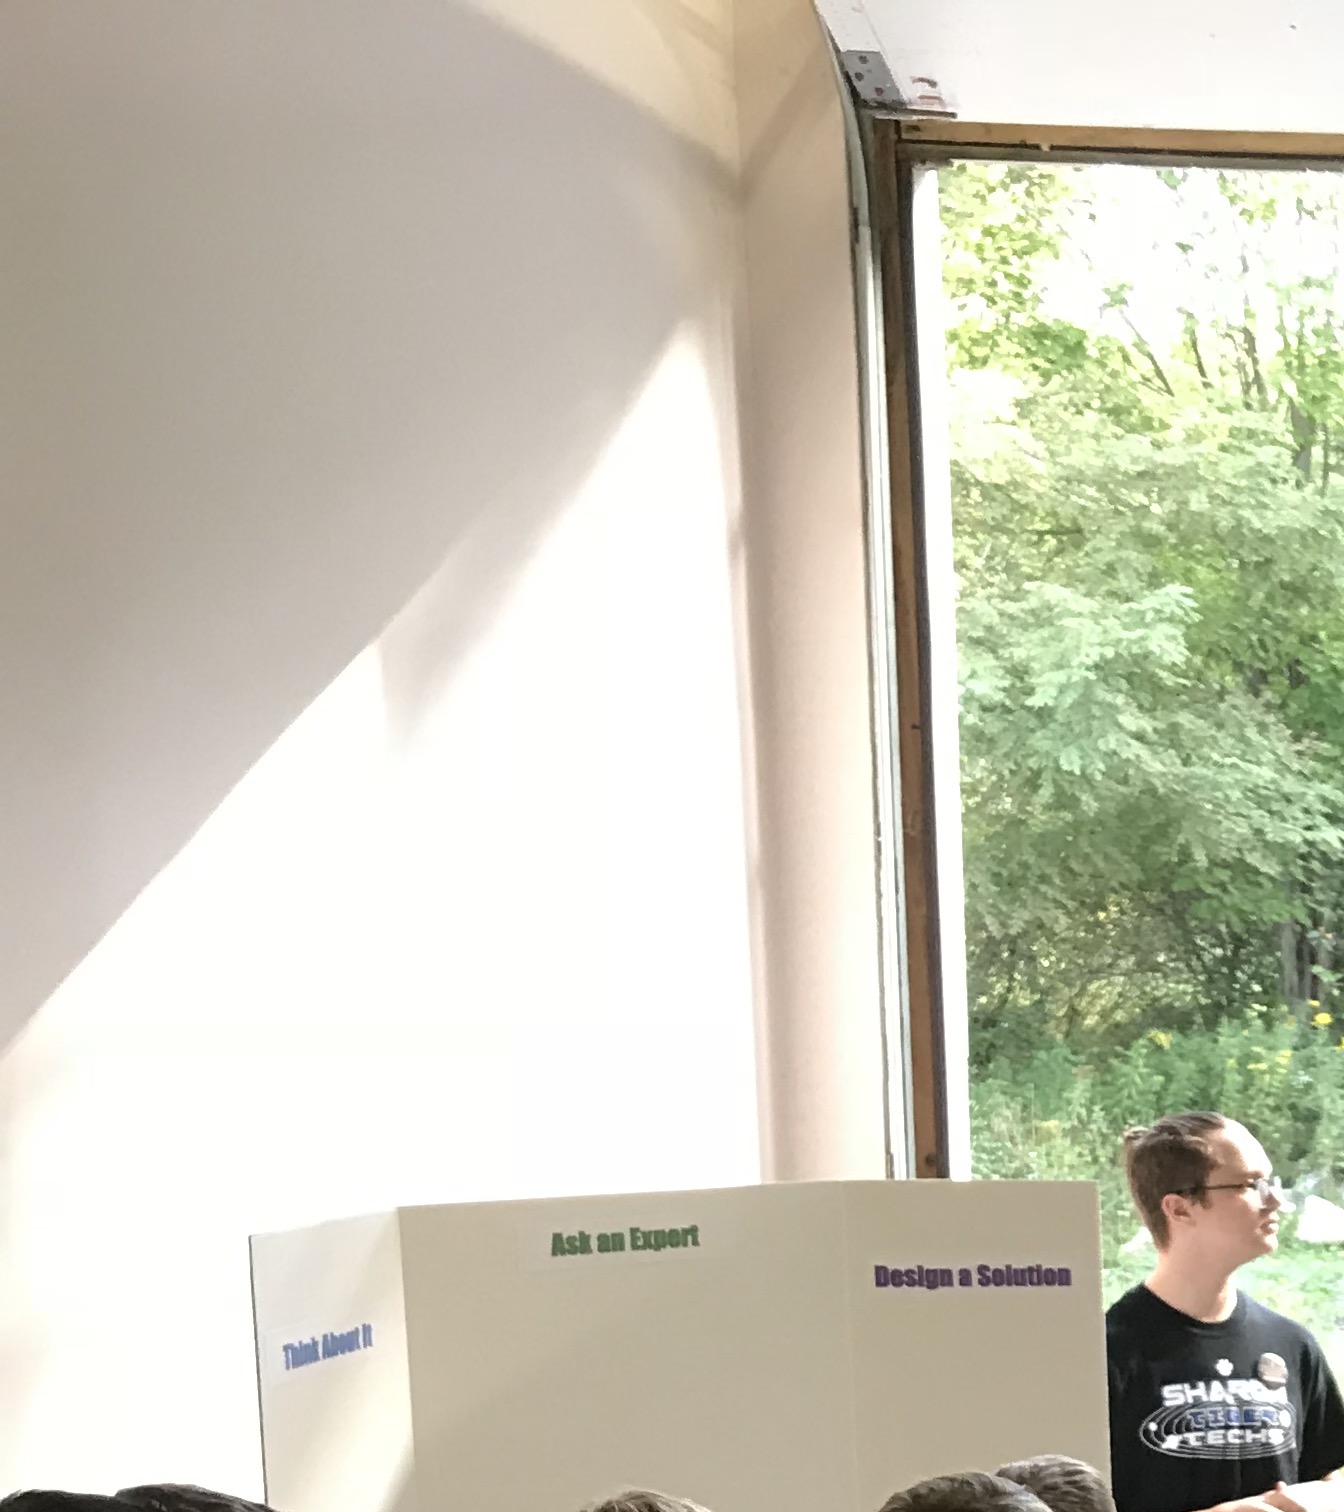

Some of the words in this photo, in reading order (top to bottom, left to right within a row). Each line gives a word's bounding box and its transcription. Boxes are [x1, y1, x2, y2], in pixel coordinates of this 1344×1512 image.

[552, 1231, 593, 1256] Ask
[597, 1232, 625, 1253] an
[630, 1225, 700, 1251] Expert
[874, 1264, 954, 1290] Design
[958, 1268, 973, 1287] a
[977, 1263, 1072, 1287] Solution
[282, 1337, 320, 1370] Think
[322, 1326, 361, 1360] About
